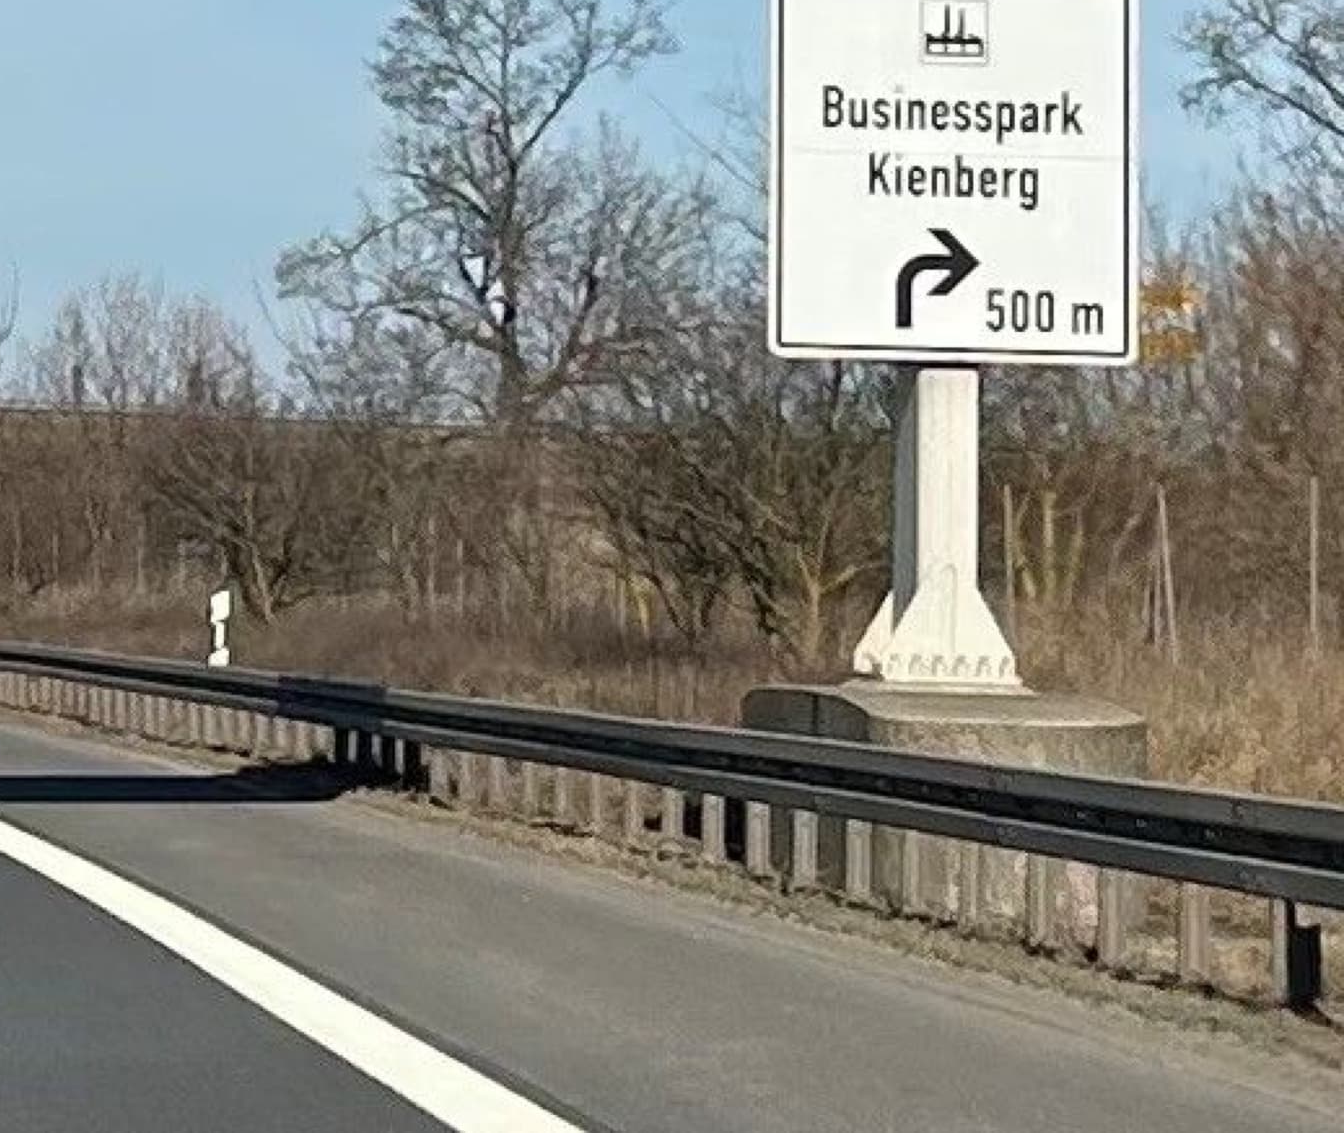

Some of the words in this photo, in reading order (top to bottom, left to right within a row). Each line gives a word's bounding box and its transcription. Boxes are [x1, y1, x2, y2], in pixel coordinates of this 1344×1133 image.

[822, 85, 1083, 144] Businesspark
[868, 152, 1039, 211] Kienberg
[986, 289, 1055, 333] 500
[1071, 303, 1104, 335] m
